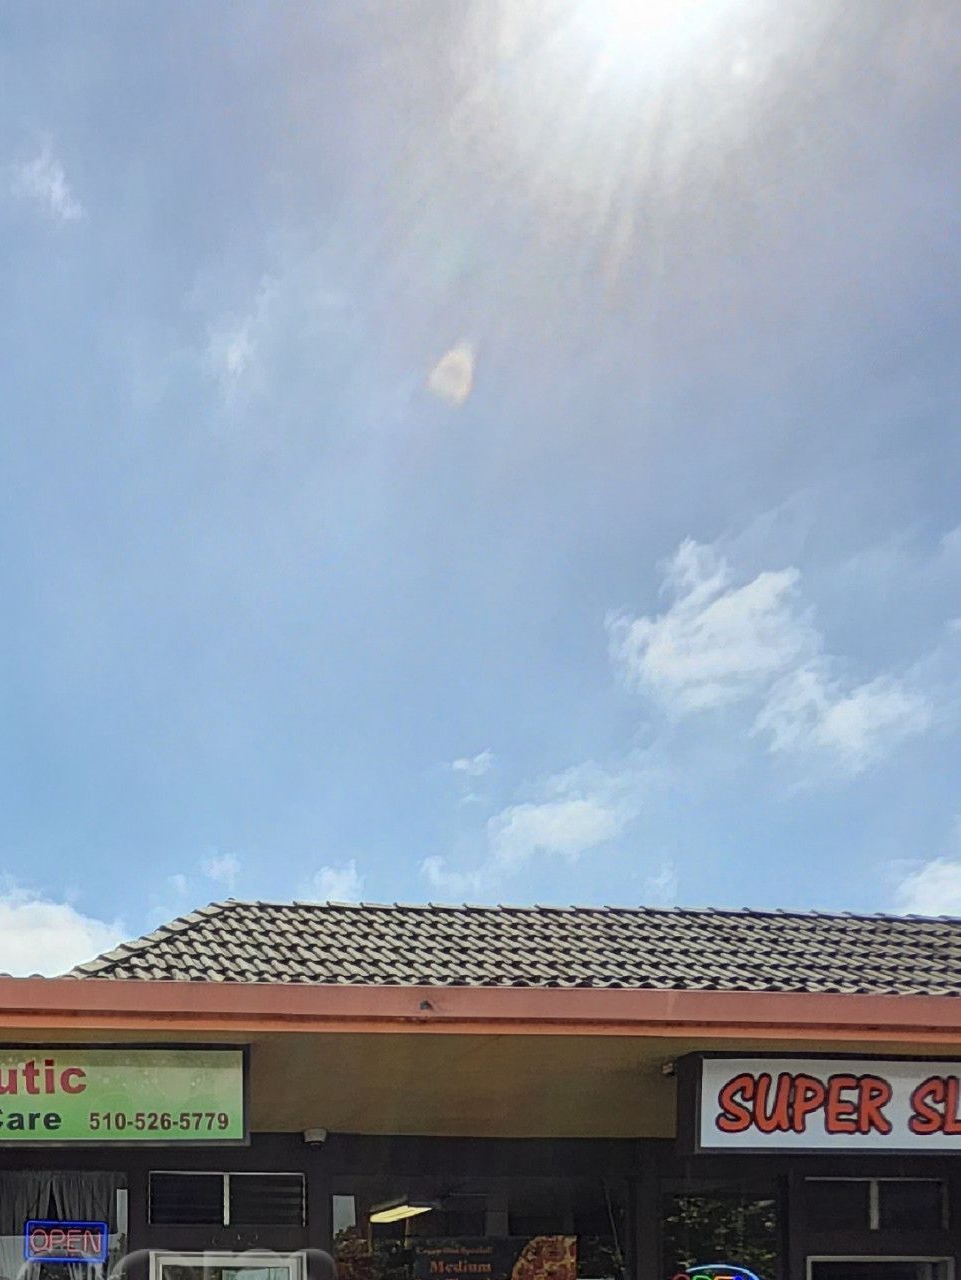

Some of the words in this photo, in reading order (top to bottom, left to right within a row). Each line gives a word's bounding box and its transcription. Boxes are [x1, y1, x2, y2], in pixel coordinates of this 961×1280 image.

[716, 1072, 892, 1135] SUPER
[89, 1112, 229, 1131] 510-526-5779
[30, 1228, 101, 1252] OPEN
[430, 1260, 491, 1274] Medium
